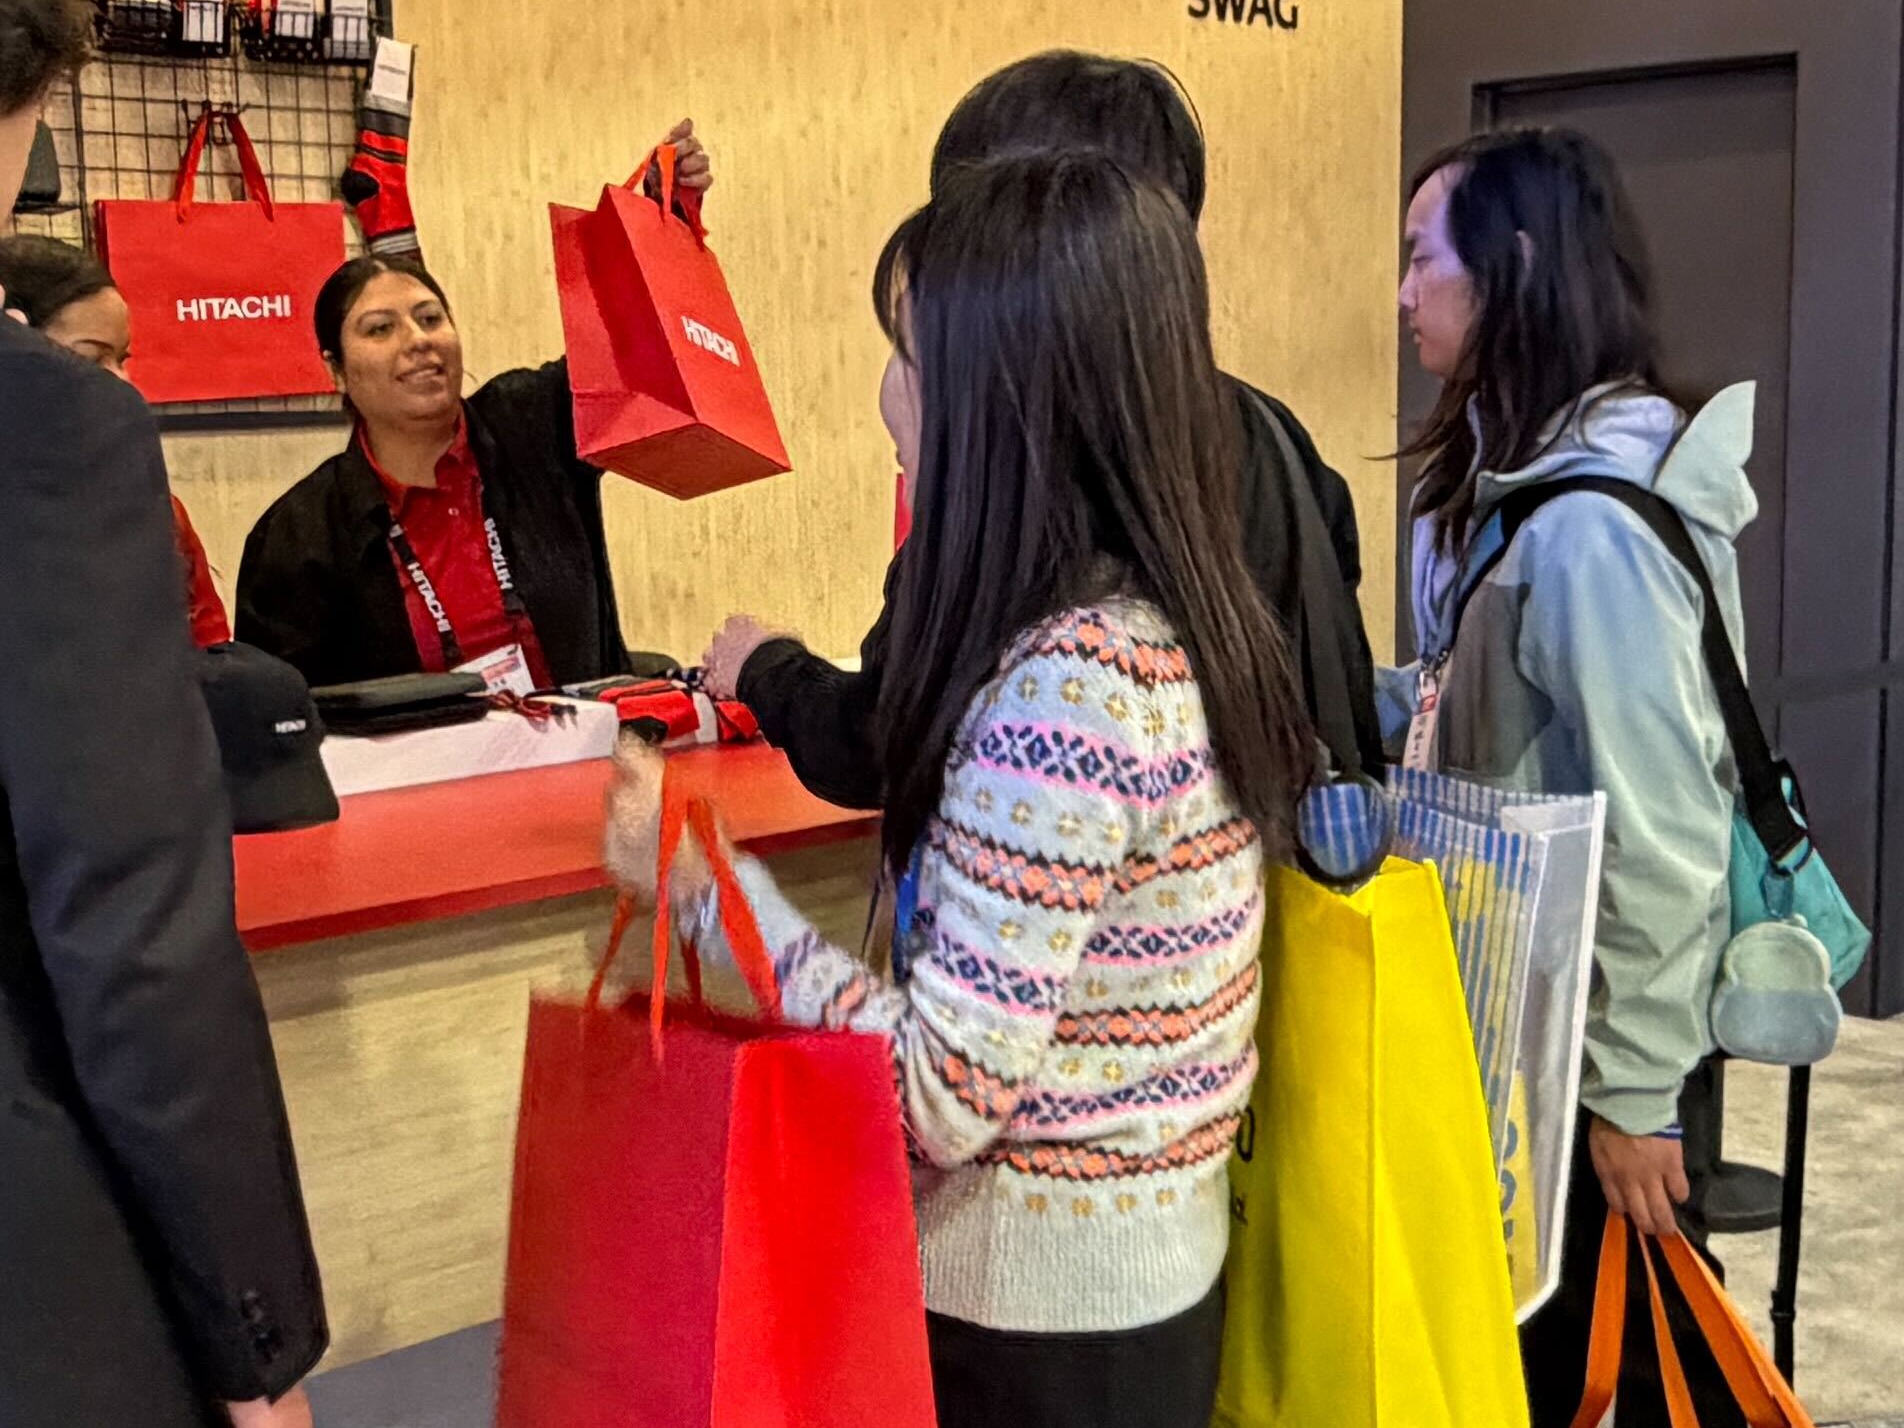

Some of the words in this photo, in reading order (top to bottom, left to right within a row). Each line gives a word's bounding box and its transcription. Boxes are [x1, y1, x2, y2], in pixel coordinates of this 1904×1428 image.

[176, 294, 292, 322] HITACHI
[680, 315, 741, 368] HITACHI
[407, 561, 452, 633] HITACHI
